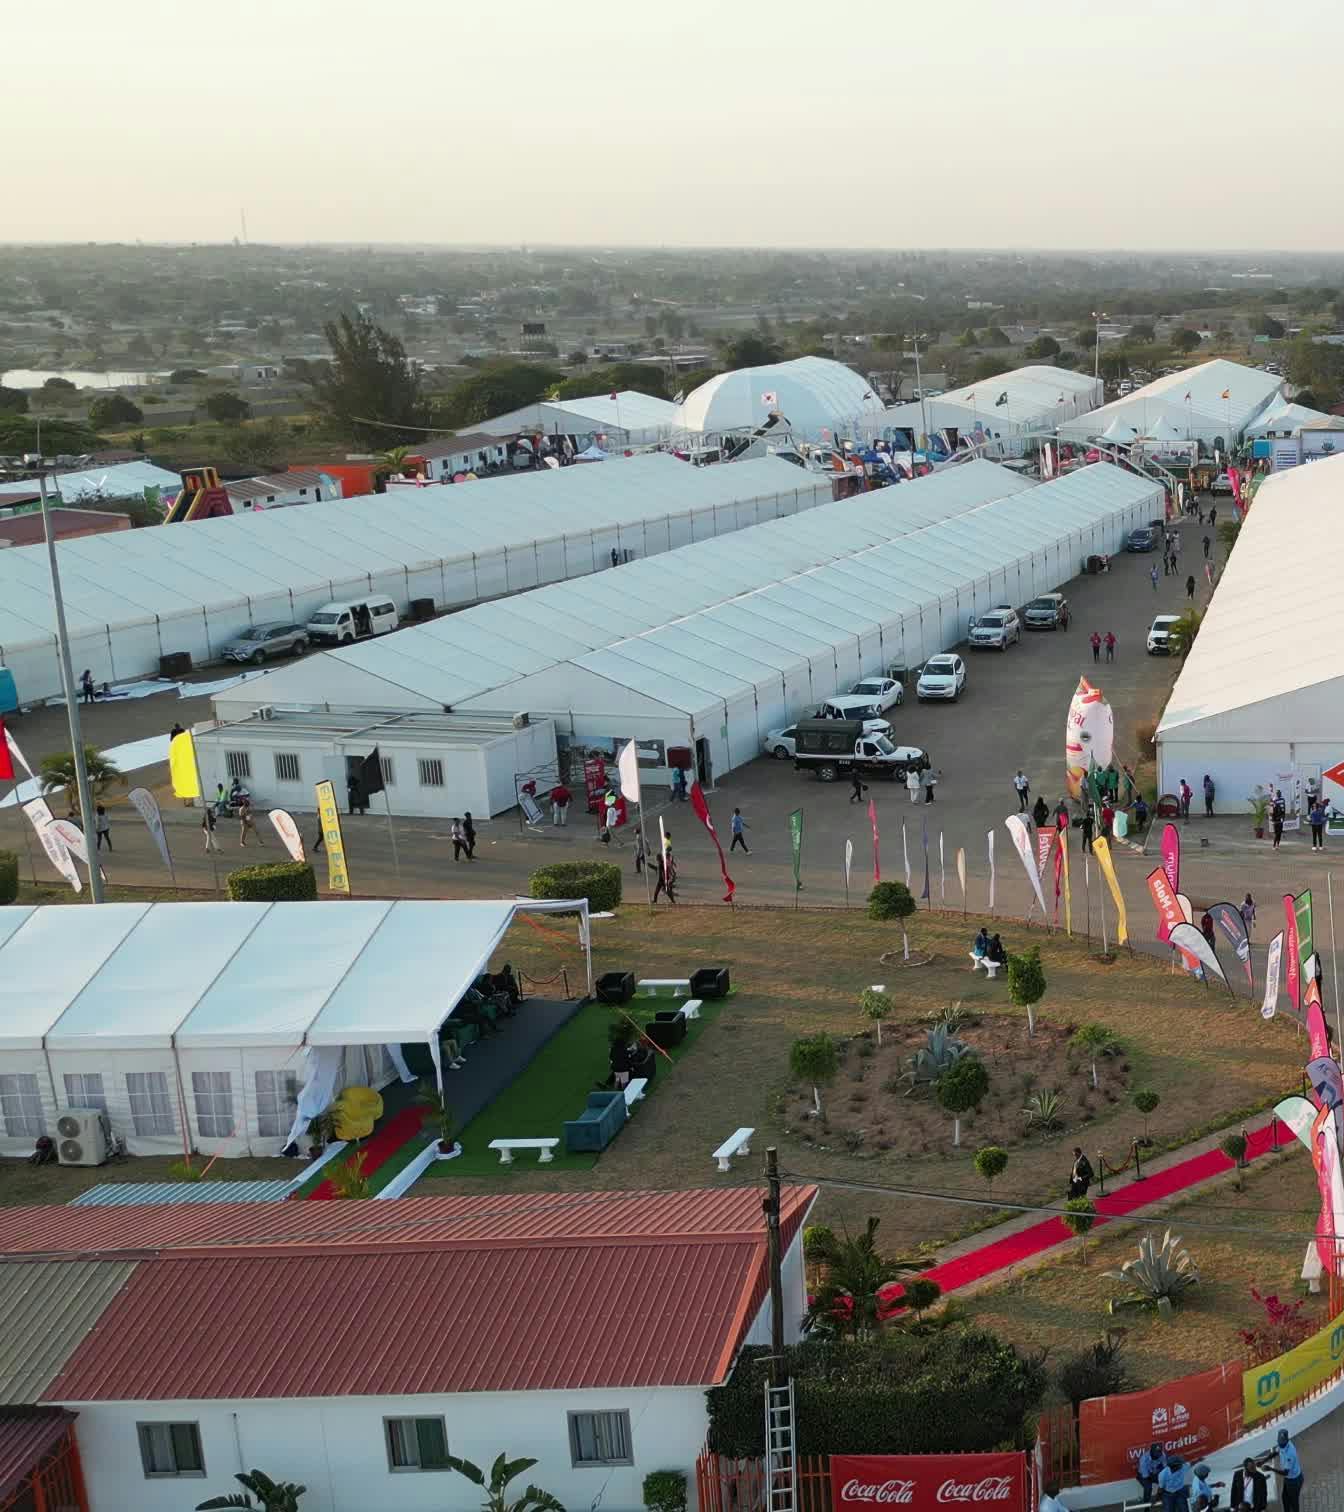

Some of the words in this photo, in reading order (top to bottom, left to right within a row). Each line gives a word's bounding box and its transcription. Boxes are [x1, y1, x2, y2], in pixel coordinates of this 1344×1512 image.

[1165, 1434, 1198, 1451] Grátis
[841, 1478, 919, 1504] Coca-Cola
[936, 1475, 1017, 1503] Coca-Cola
